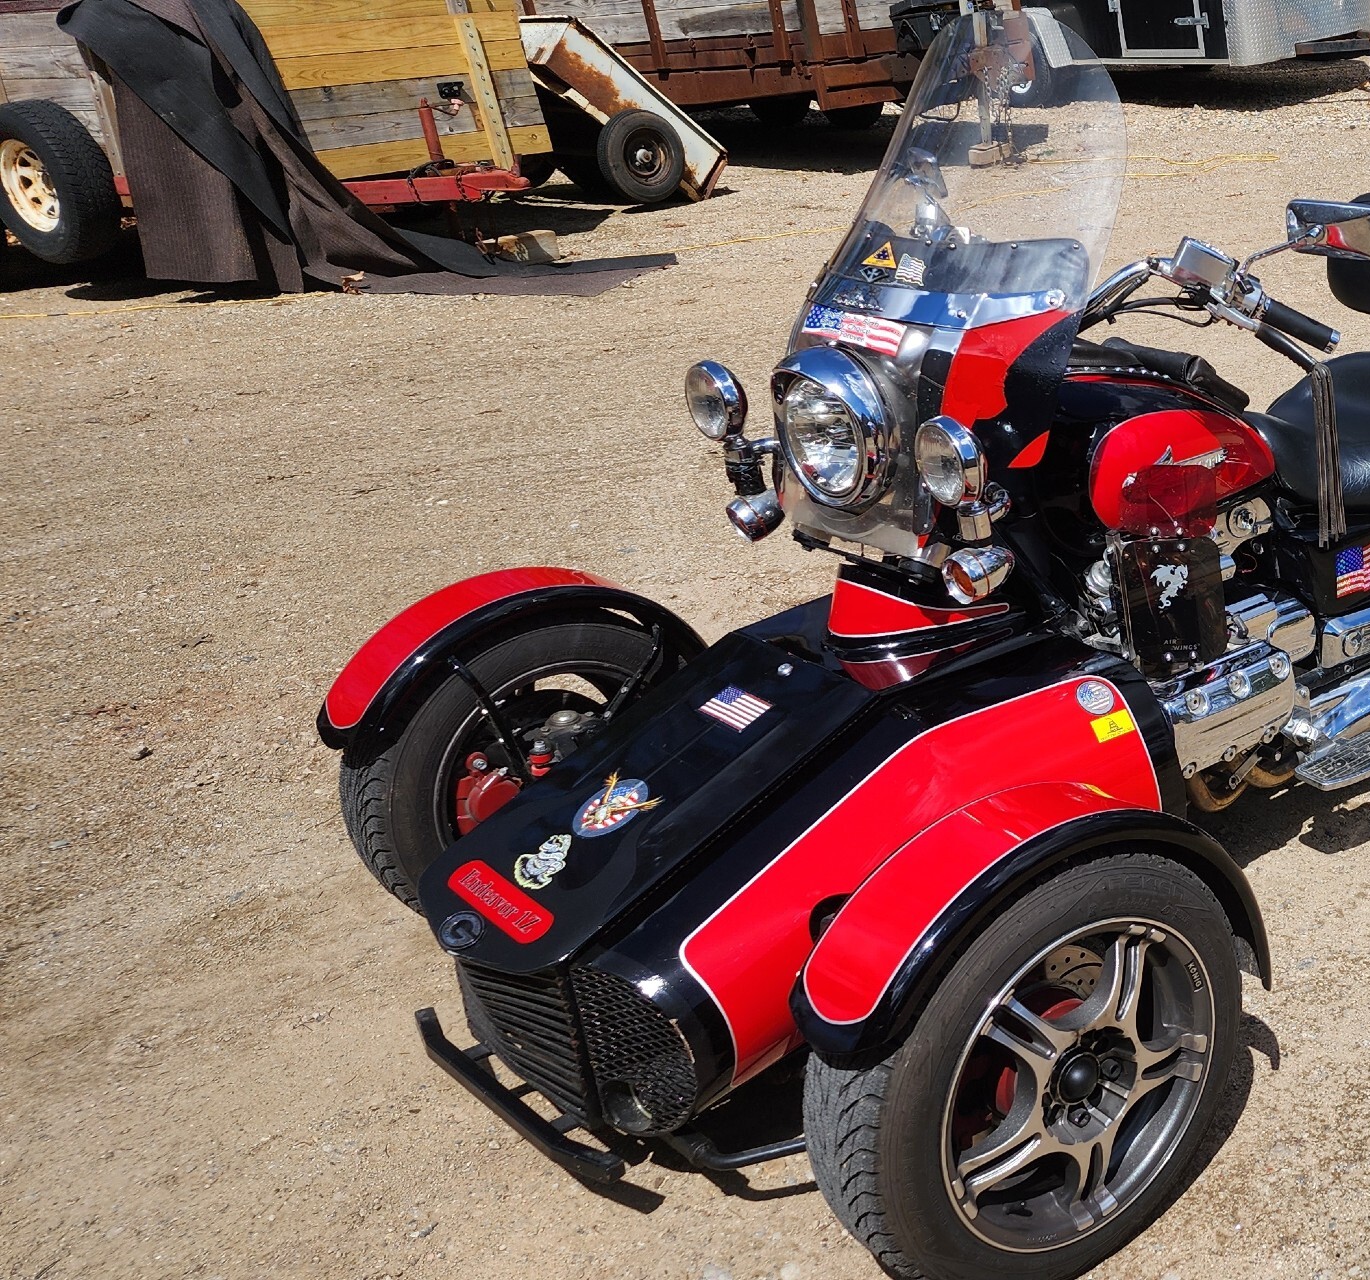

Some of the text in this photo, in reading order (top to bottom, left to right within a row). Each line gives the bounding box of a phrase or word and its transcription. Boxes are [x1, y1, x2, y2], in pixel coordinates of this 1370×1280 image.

[846, 322, 871, 335] Choice
[840, 330, 865, 342] Forever
[1172, 643, 1198, 651] WINGS
[458, 867, 519, 919] Endeavor
